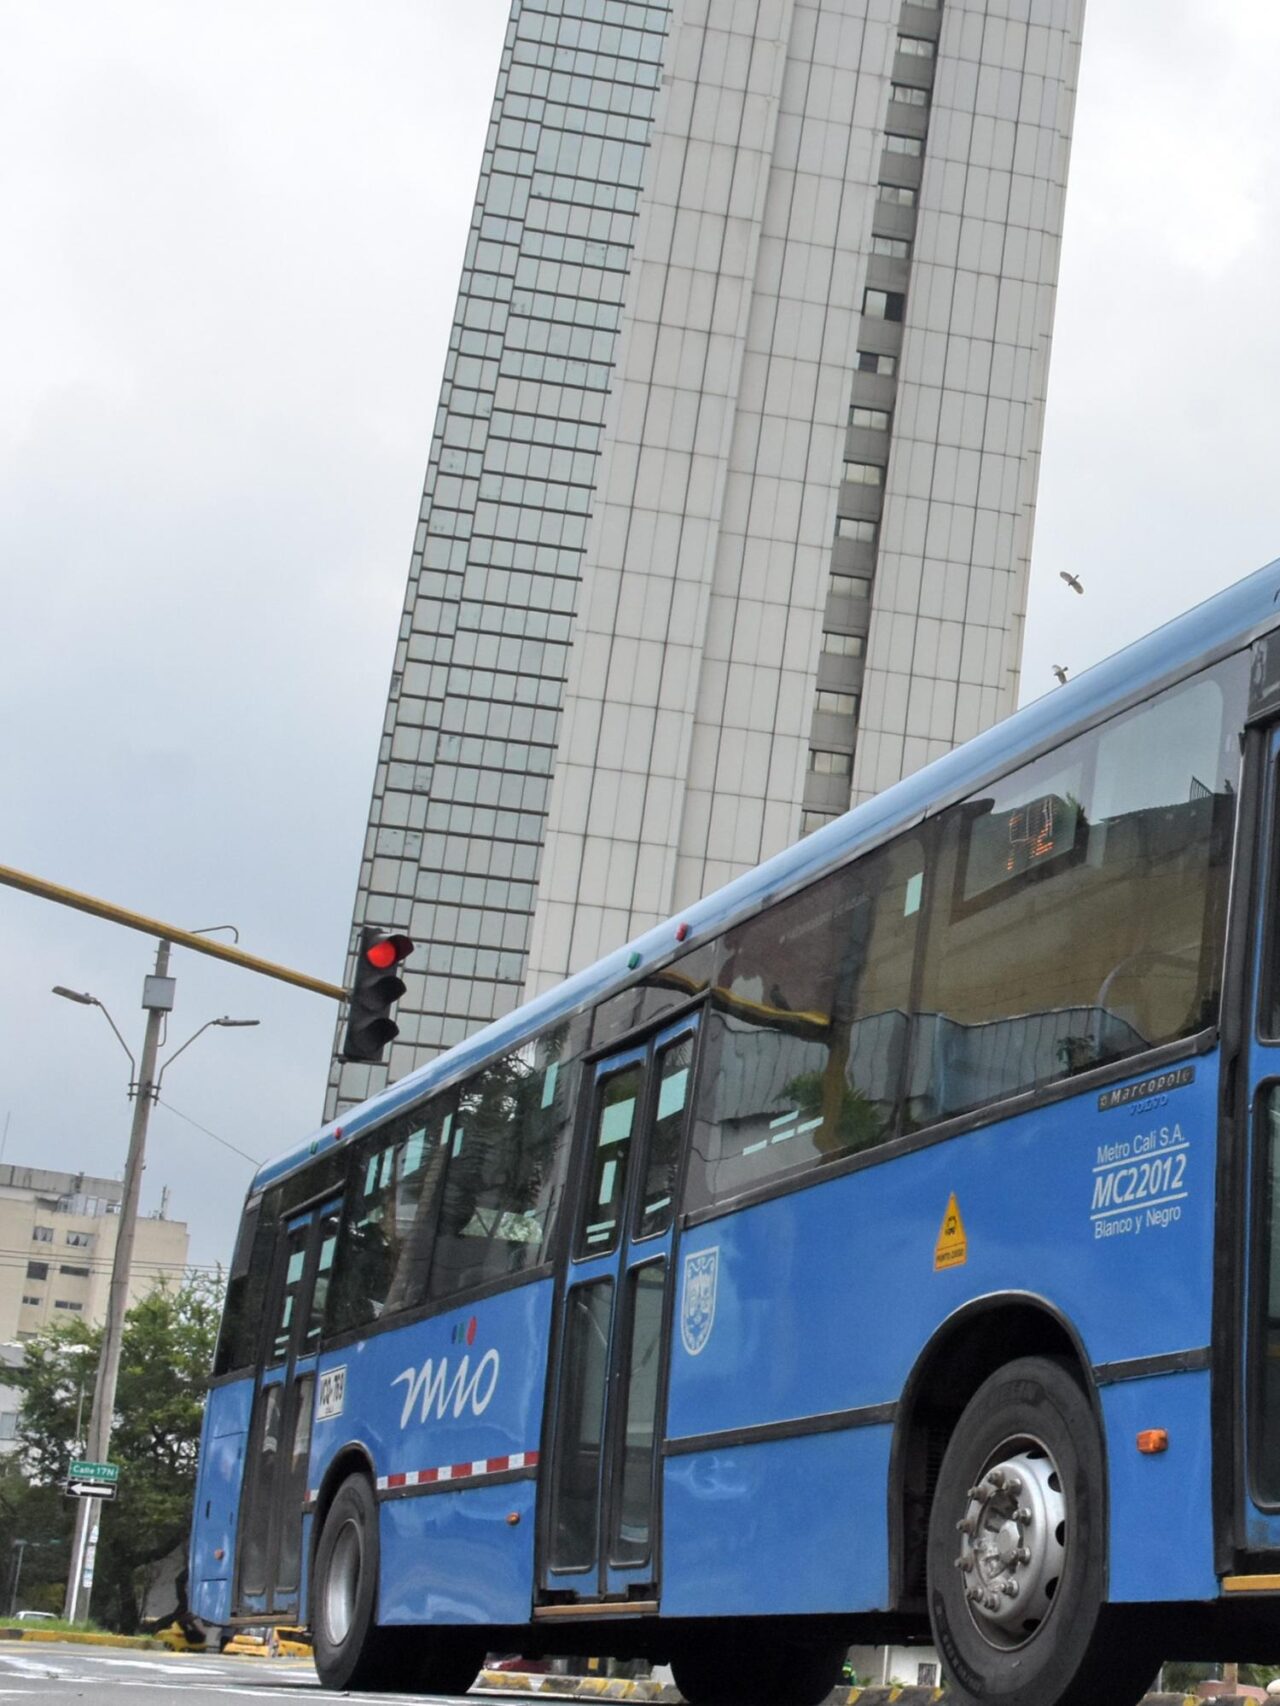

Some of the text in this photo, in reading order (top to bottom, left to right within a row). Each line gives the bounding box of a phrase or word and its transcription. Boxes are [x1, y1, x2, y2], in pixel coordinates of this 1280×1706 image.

[1097, 1123, 1185, 1164] Metro Cali S.A.
[1091, 1153, 1187, 1210] MC22012
[1095, 1205, 1181, 1239] Blanco y Negro
[72, 1464, 115, 1477] Calle 17N
